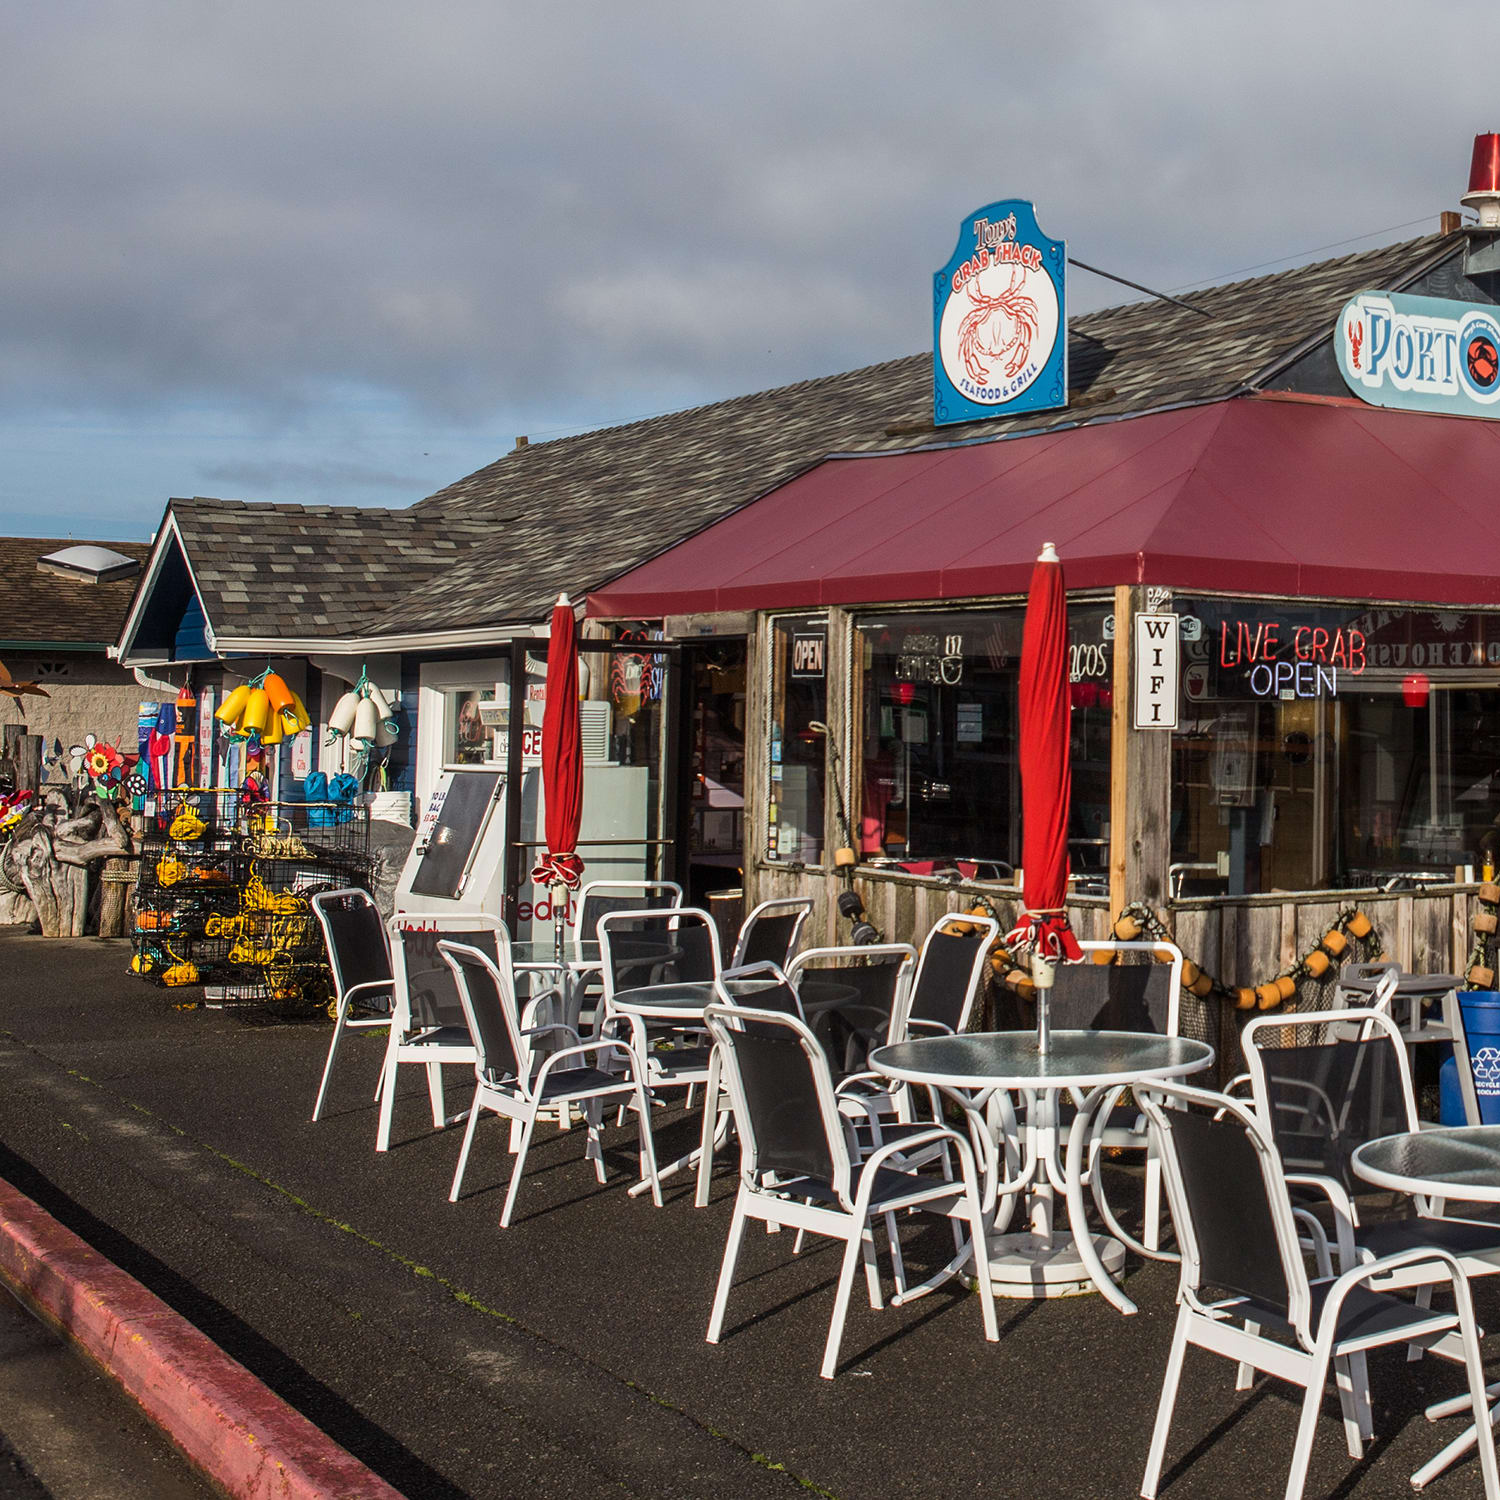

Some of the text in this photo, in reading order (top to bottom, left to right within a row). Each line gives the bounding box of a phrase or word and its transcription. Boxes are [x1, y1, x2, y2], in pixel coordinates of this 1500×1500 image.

[974, 211, 1017, 249] Tony's
[952, 241, 1042, 293] CRAB SHACK
[1364, 306, 1457, 384] PORT
[960, 363, 1038, 400] SEAFOOD & GRILL
[794, 640, 822, 670] OPEN
[1069, 644, 1107, 676] ACOS
[1221, 620, 1366, 675] LIVE CRAB
[1145, 621, 1170, 722] WIFI
[1251, 662, 1337, 697] OPEN
[522, 731, 541, 755] CE
[501, 893, 577, 927] eddy
